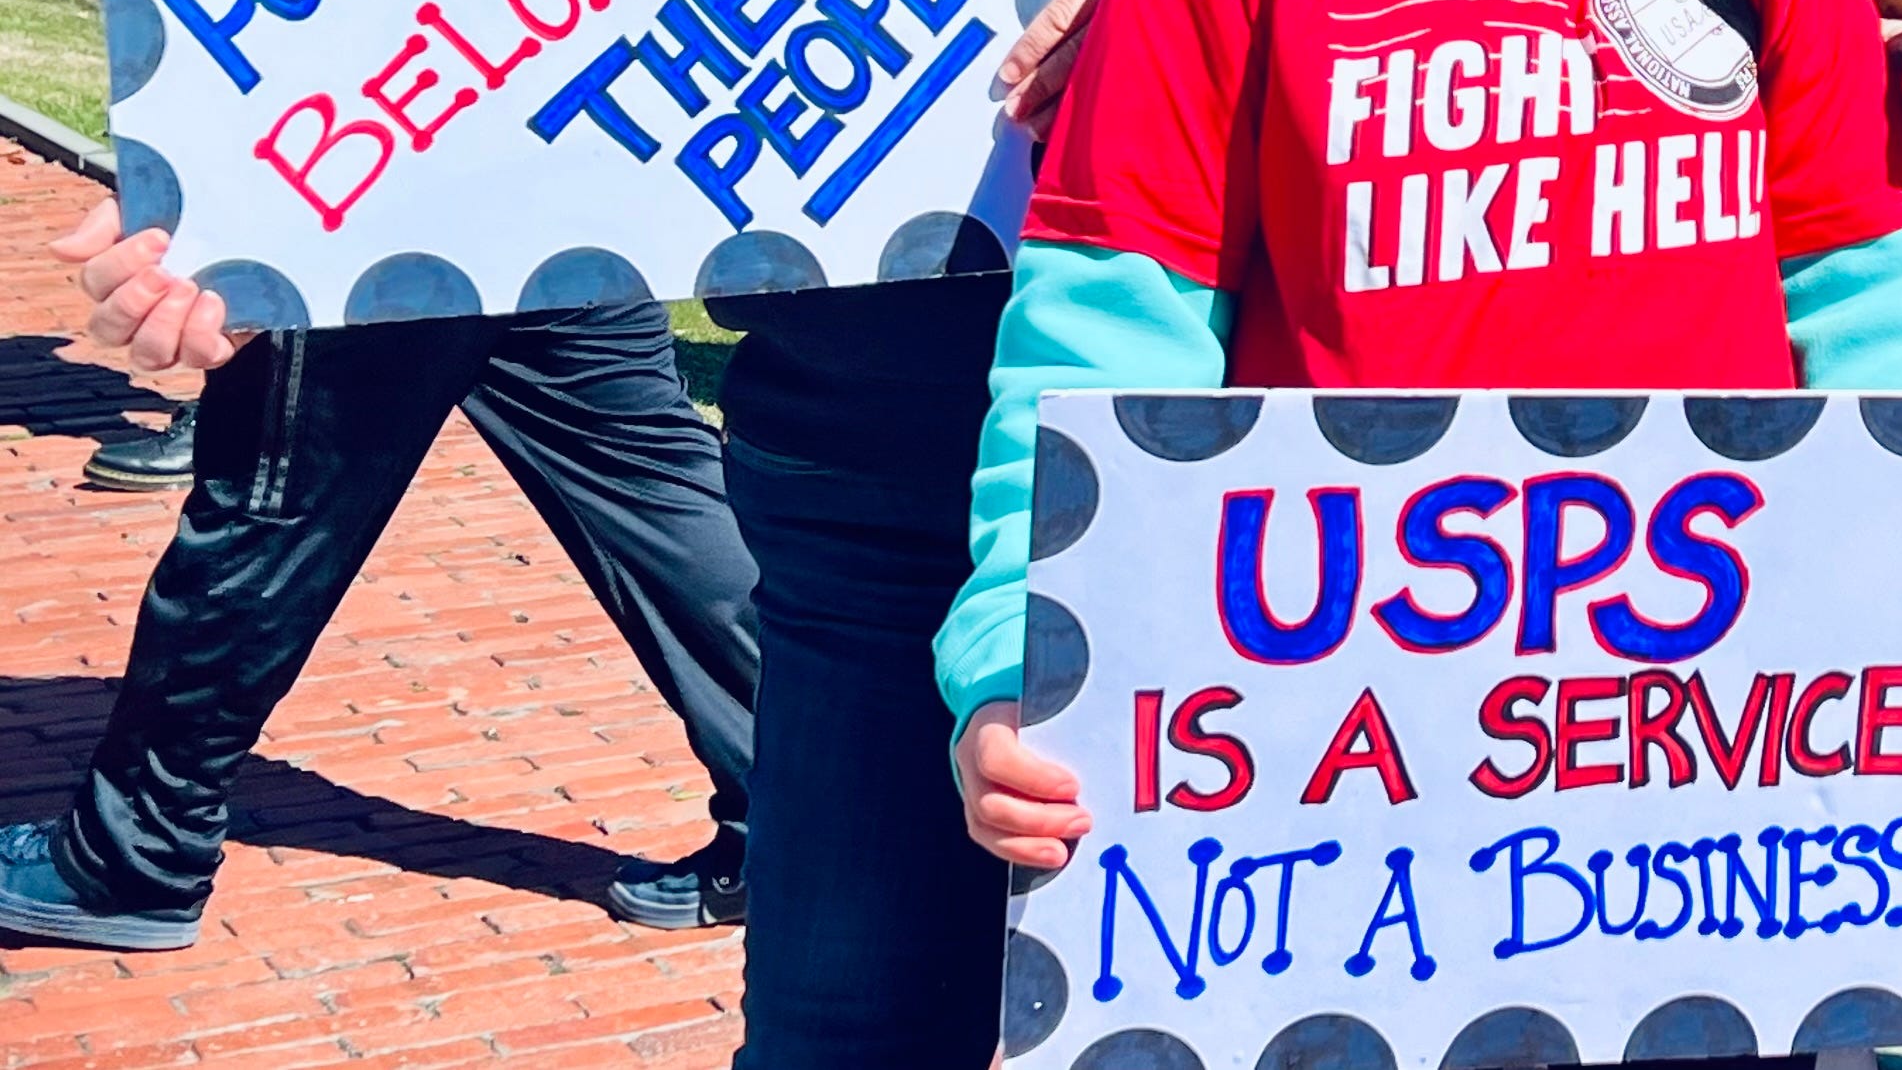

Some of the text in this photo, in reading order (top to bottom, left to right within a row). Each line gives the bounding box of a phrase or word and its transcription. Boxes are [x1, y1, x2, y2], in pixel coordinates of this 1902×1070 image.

[1626, 32, 1692, 99] NATIONAL
[1344, 156, 1560, 293] LIKE
[1216, 470, 1766, 666] USPS
[1133, 685, 1256, 814] IS
[1300, 686, 1419, 806] A
[1093, 837, 1342, 1002] NOT
[1344, 847, 1437, 982] A
